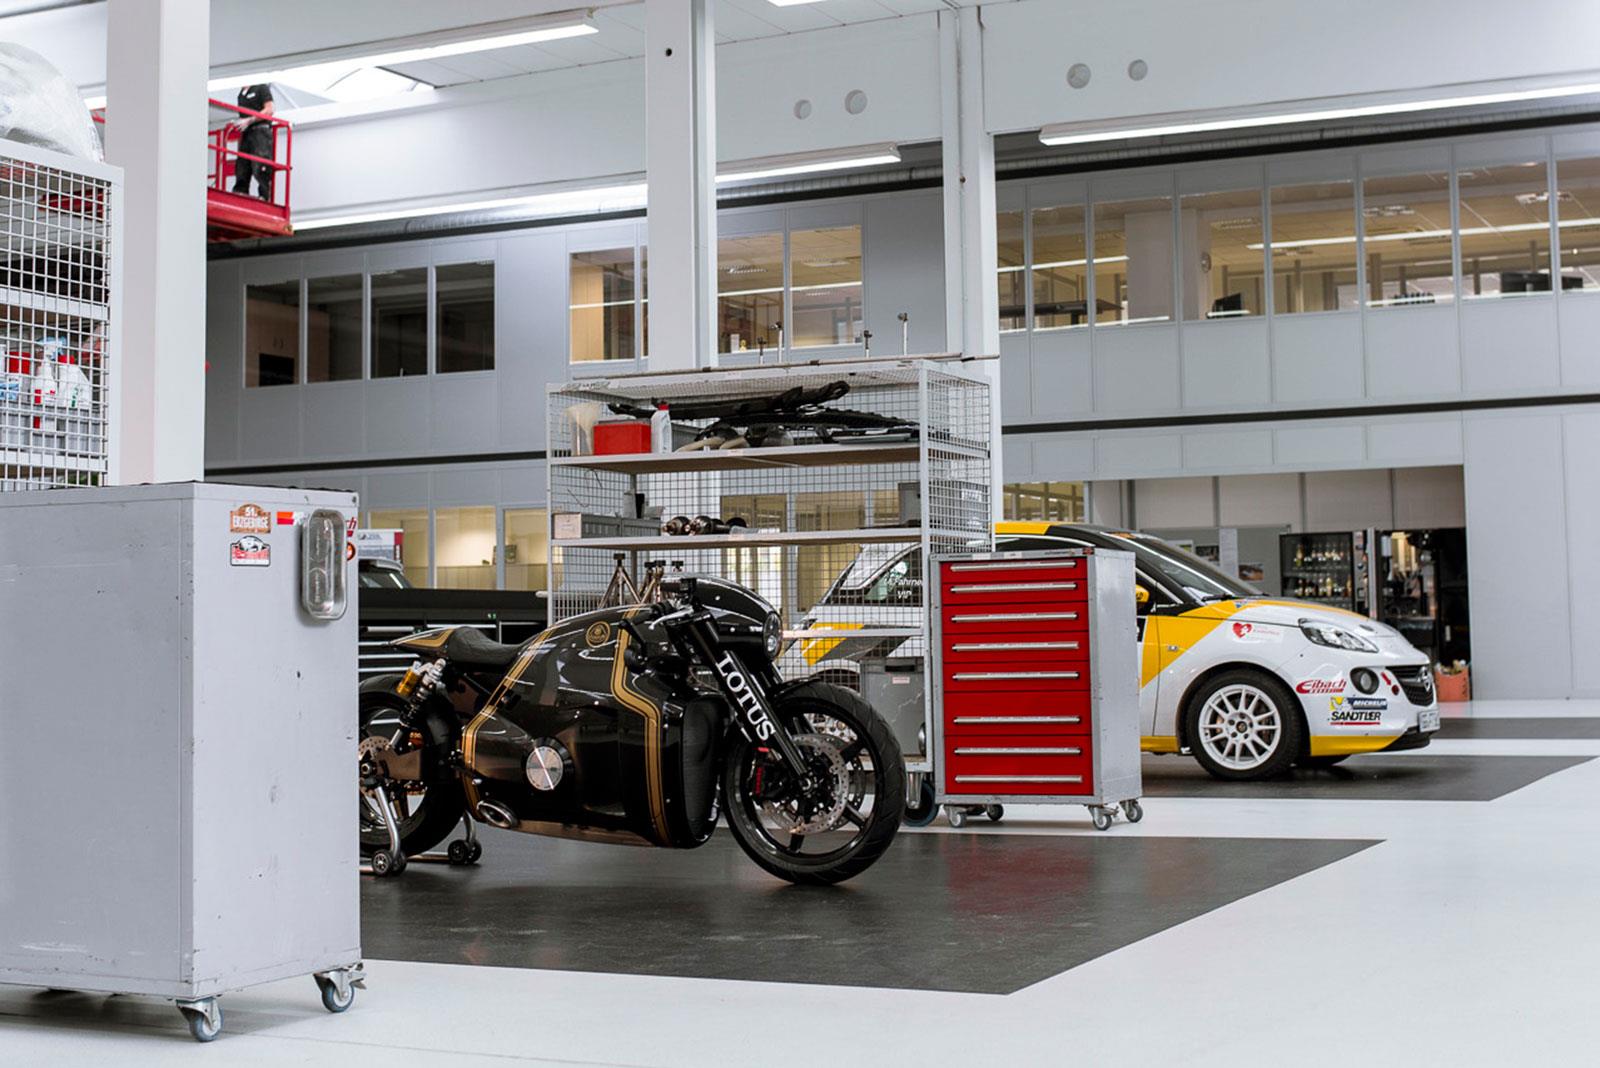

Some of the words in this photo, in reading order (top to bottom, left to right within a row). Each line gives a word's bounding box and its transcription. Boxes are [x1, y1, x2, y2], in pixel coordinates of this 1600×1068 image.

[1295, 678, 1347, 694] Eibach
[715, 652, 776, 741] LOTUS
[1331, 711, 1381, 721] SANDTLER
